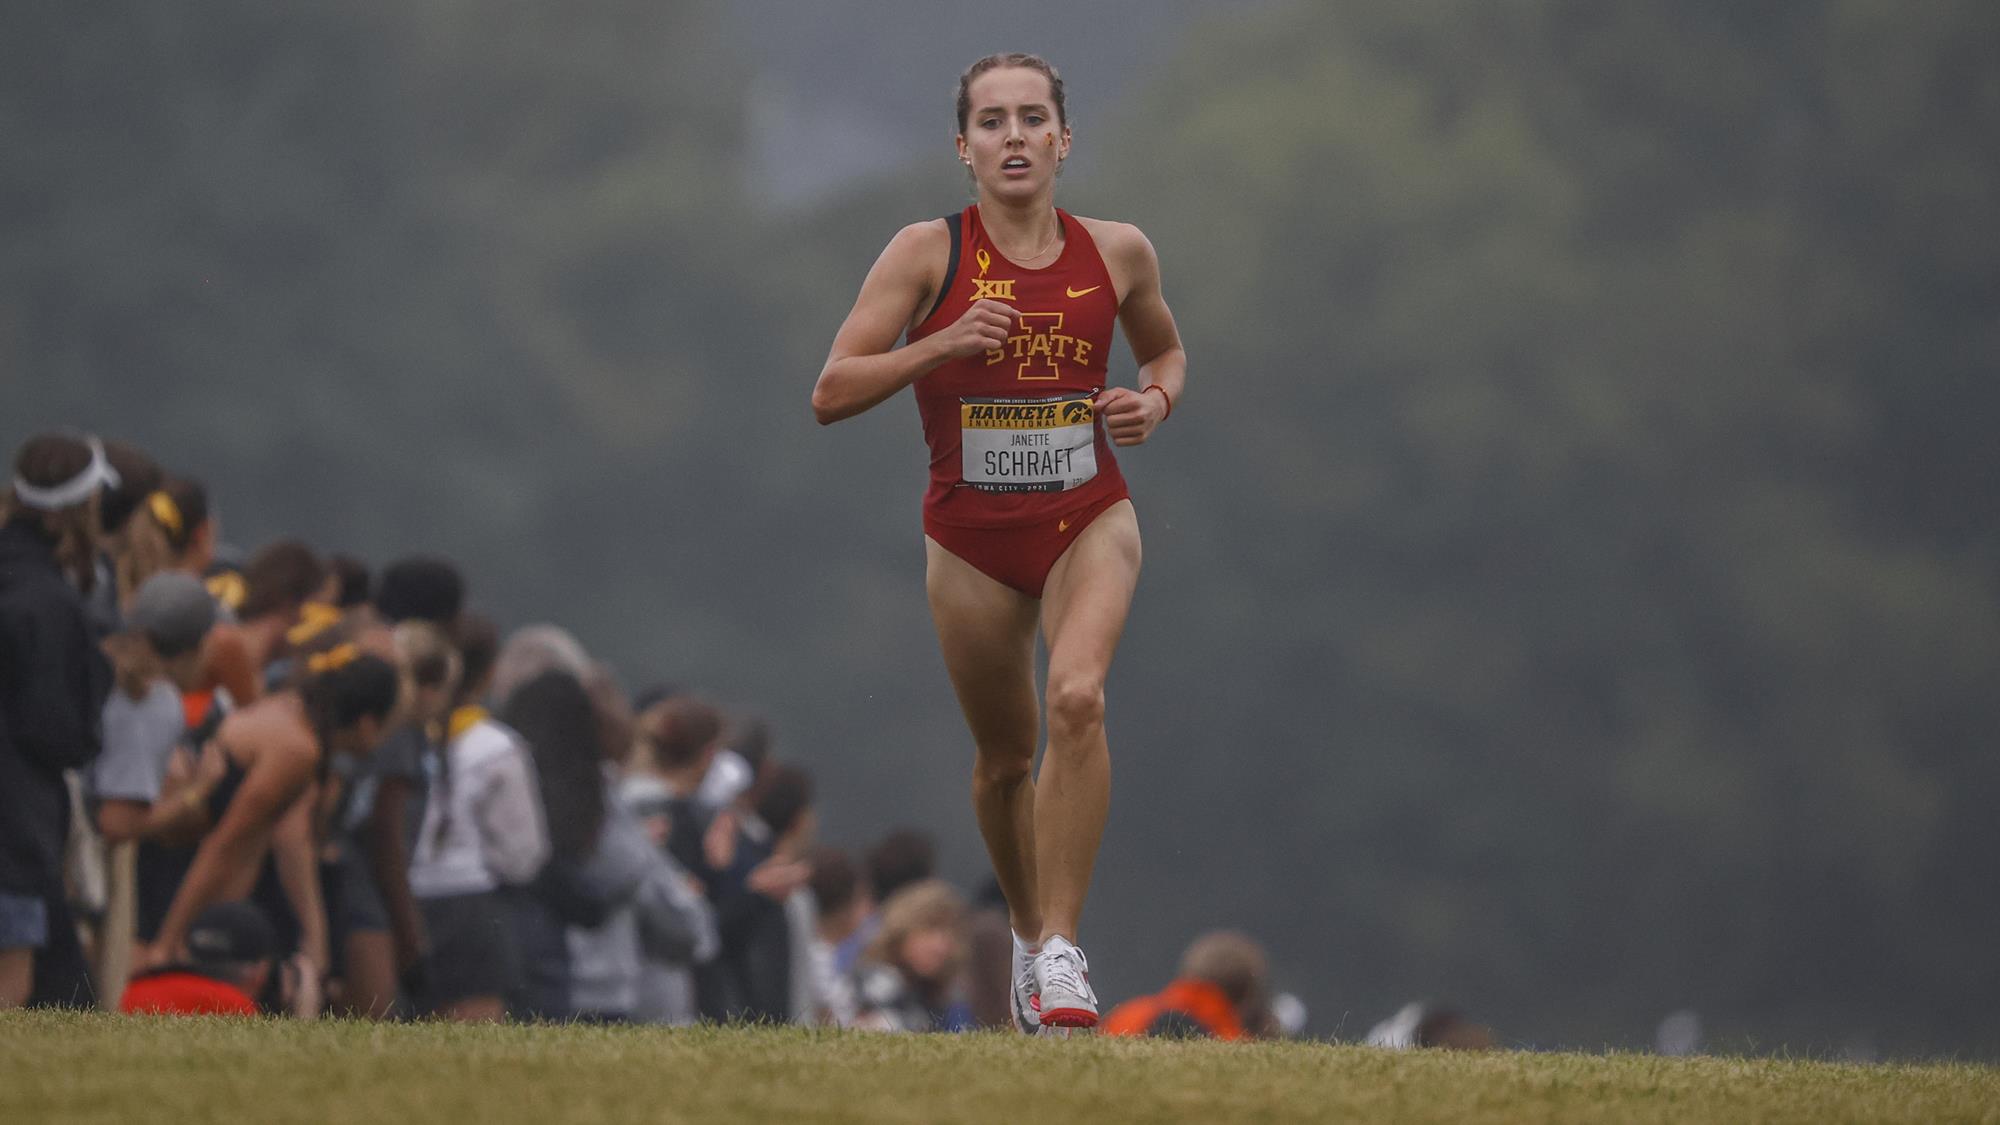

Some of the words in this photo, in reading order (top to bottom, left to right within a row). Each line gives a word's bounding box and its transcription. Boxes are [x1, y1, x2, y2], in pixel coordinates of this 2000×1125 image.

[969, 278, 1016, 301] XII
[986, 333, 1093, 366] STATE
[969, 405, 1057, 420] HAWKEYE
[969, 419, 1057, 427] INVITATIONAL
[1010, 433, 1050, 446] JANETTE
[985, 447, 1074, 476] SCHRAFT
